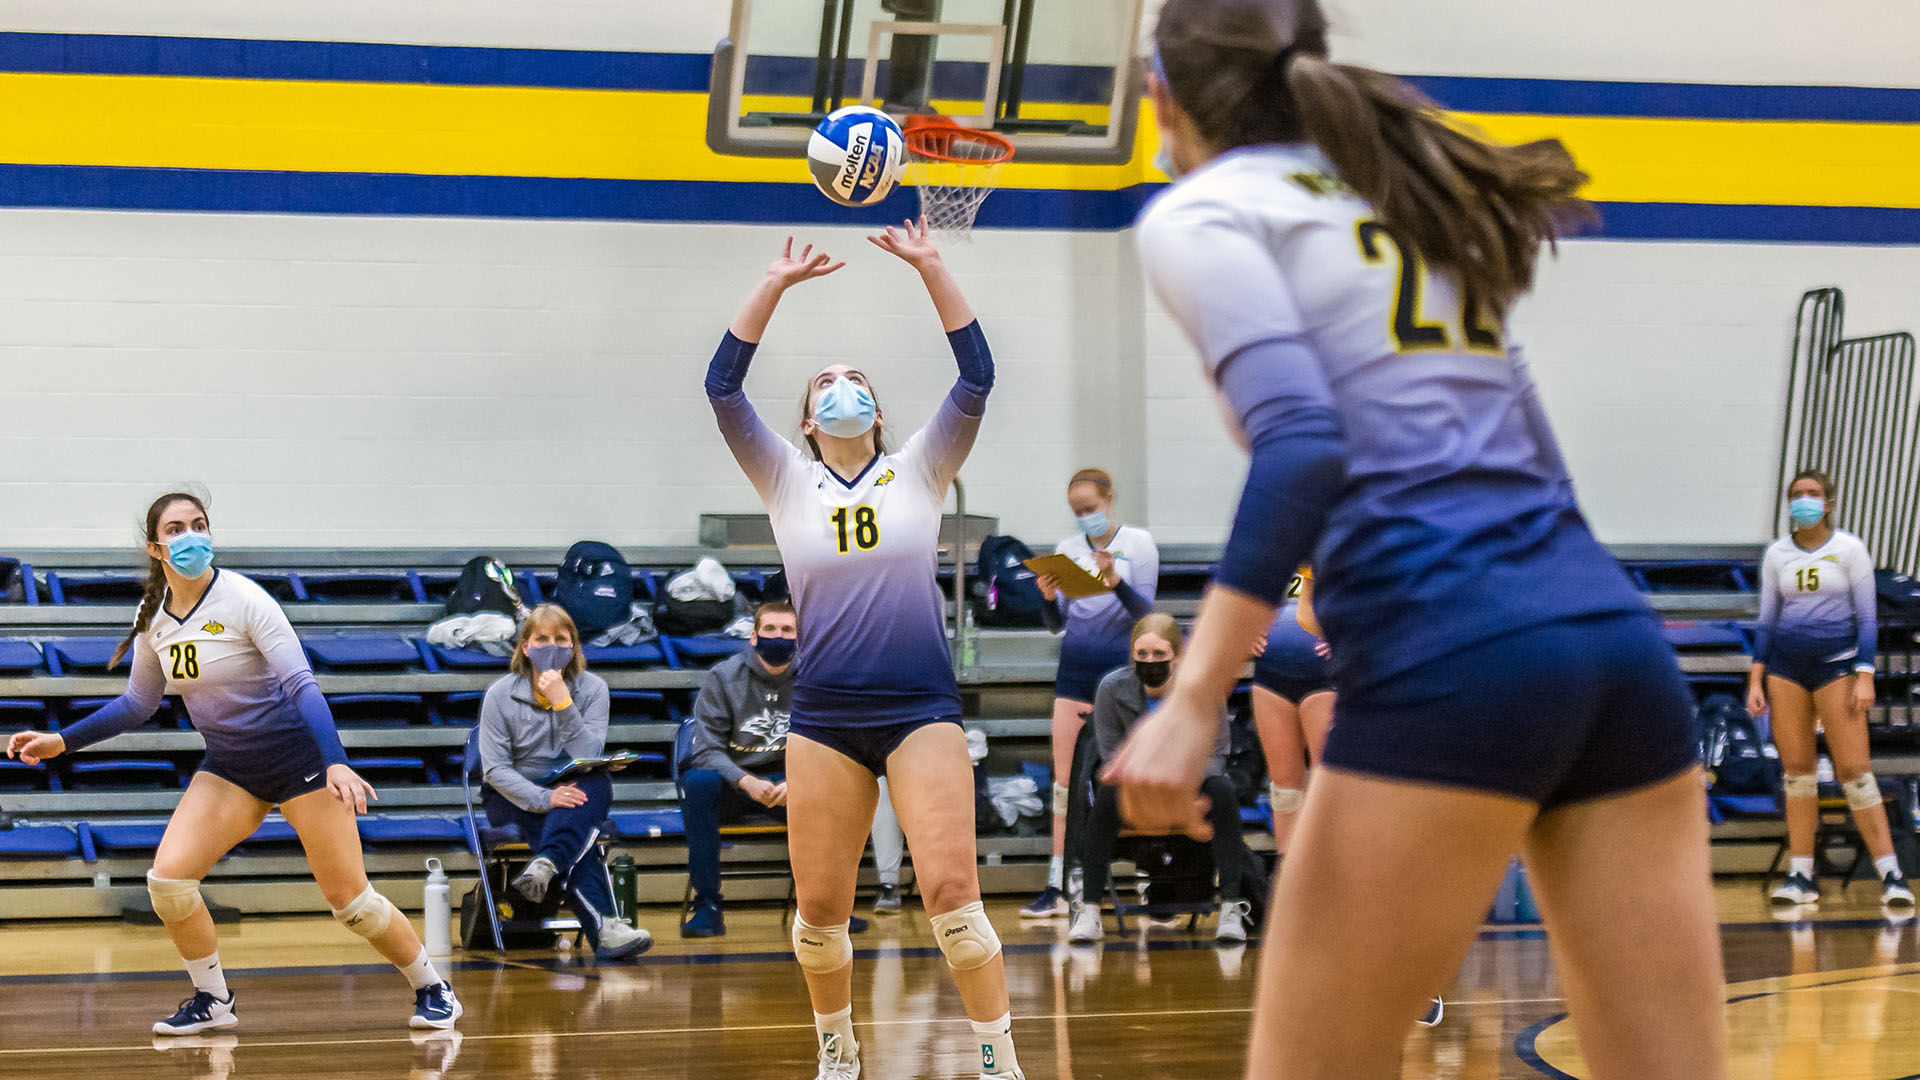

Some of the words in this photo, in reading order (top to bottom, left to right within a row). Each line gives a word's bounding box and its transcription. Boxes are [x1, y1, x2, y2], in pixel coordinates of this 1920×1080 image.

[841, 134, 867, 189] molten
[859, 142, 884, 190] NCAA
[830, 504, 880, 555] 18
[1795, 566, 1820, 592] 15
[169, 641, 200, 680] 28
